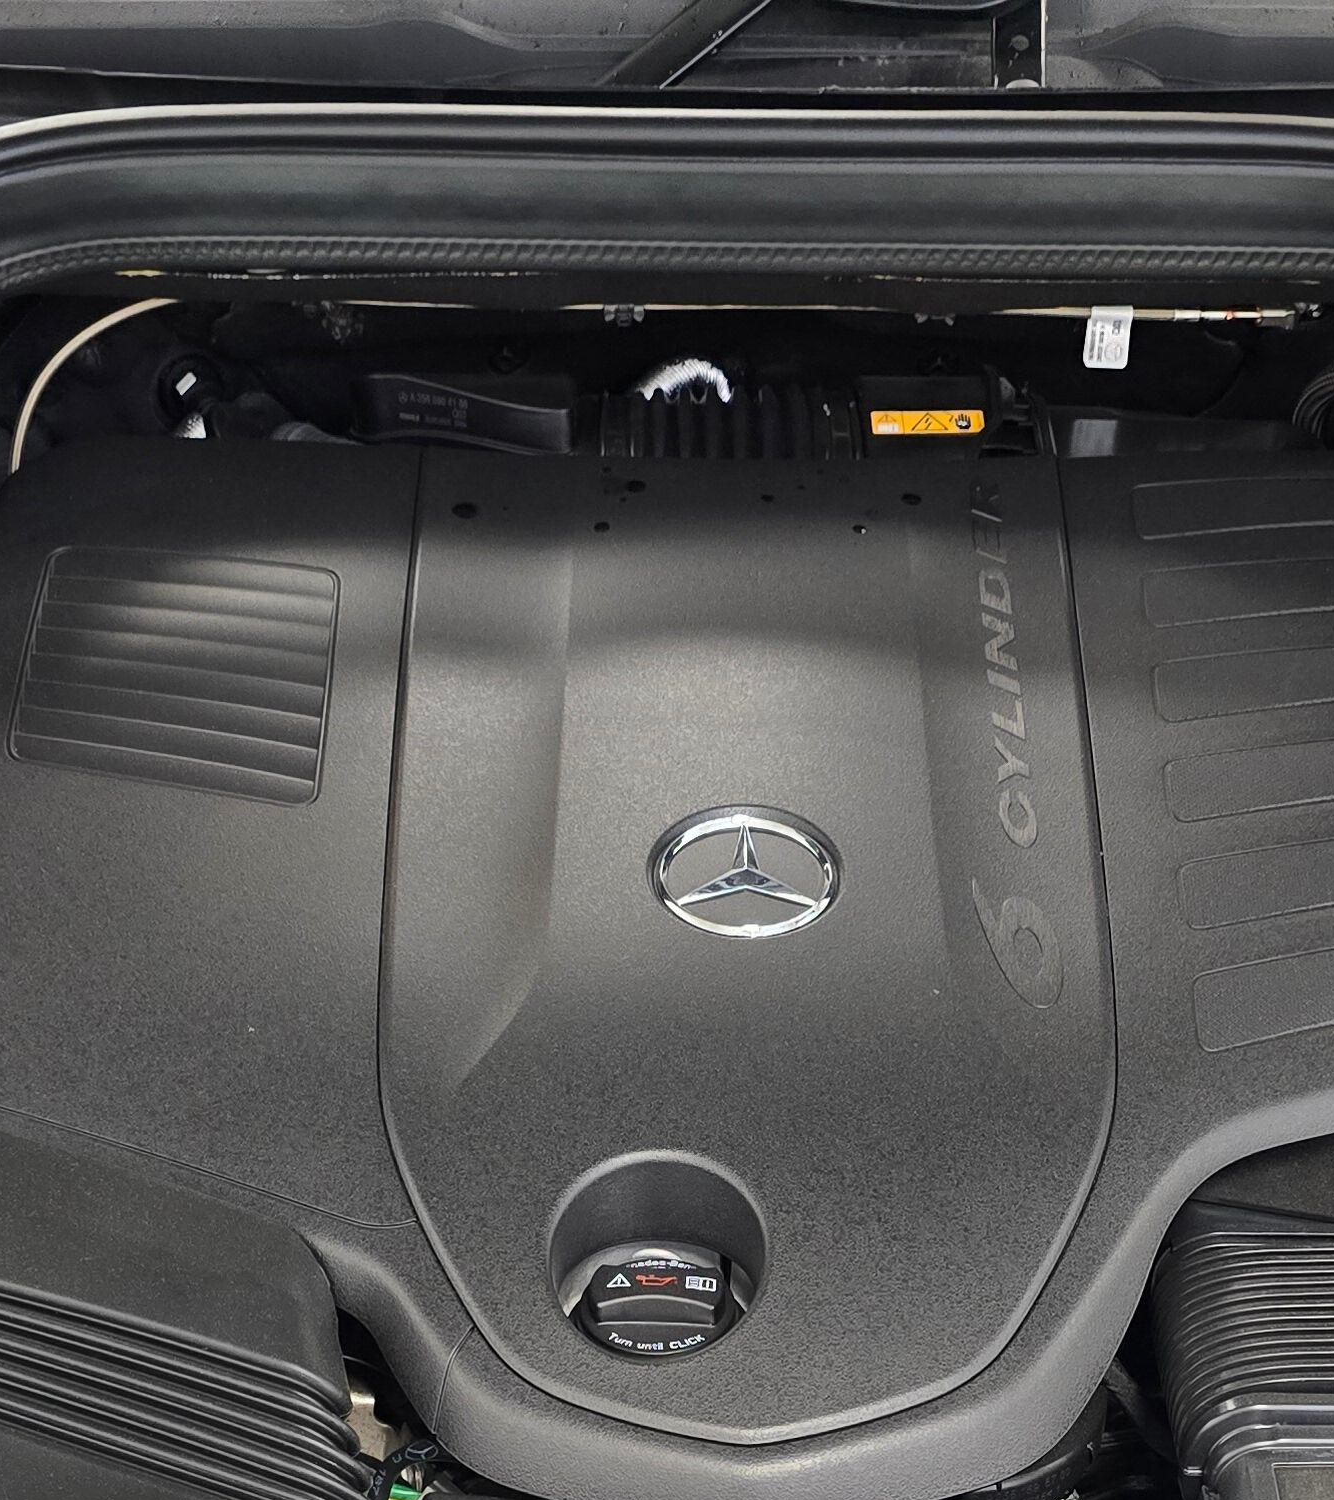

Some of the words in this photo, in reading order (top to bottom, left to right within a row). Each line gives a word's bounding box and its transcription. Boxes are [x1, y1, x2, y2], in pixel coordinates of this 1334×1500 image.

[970, 483, 1039, 849] CYLINDER
[971, 876, 1065, 1010] 6
[608, 1331, 634, 1348] Turn
[637, 1342, 664, 1351] until
[669, 1333, 706, 1350] CLICK
